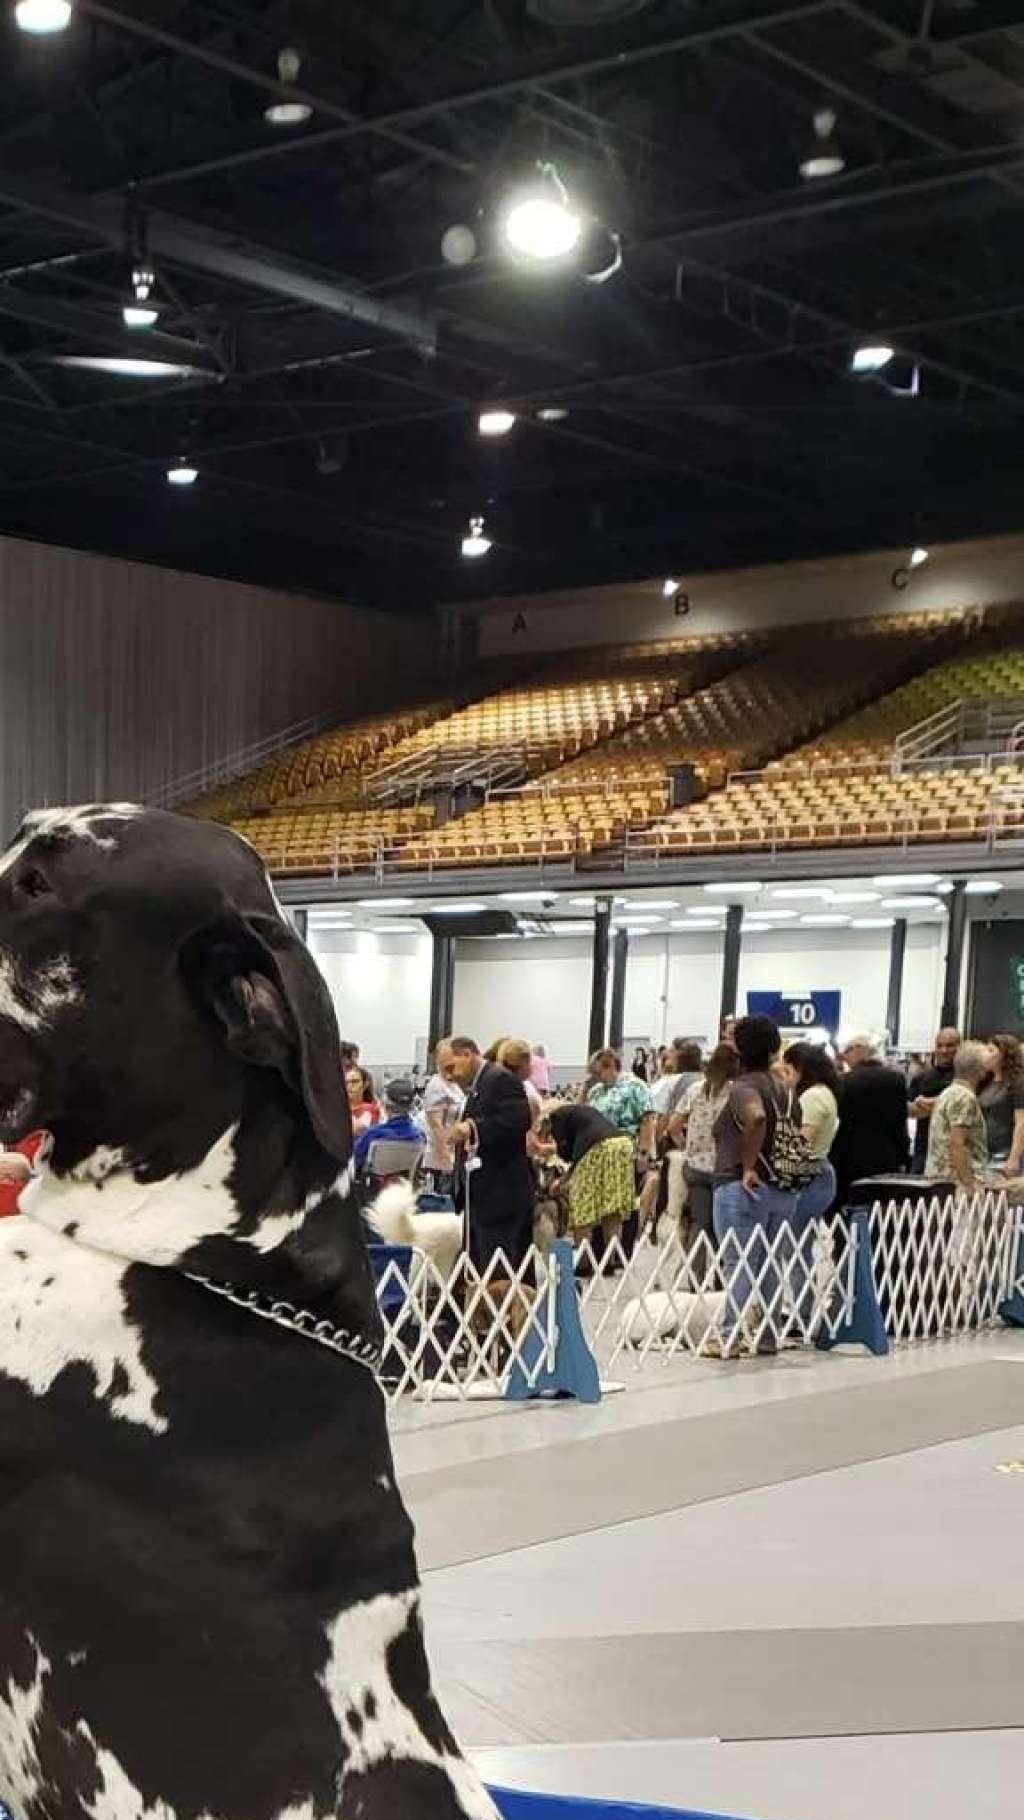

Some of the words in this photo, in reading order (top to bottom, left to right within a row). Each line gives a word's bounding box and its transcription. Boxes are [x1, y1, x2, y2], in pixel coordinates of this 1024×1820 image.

[891, 568, 907, 590] C
[675, 596, 690, 615] B
[511, 613, 527, 633] A
[789, 1003, 815, 1024] 10
